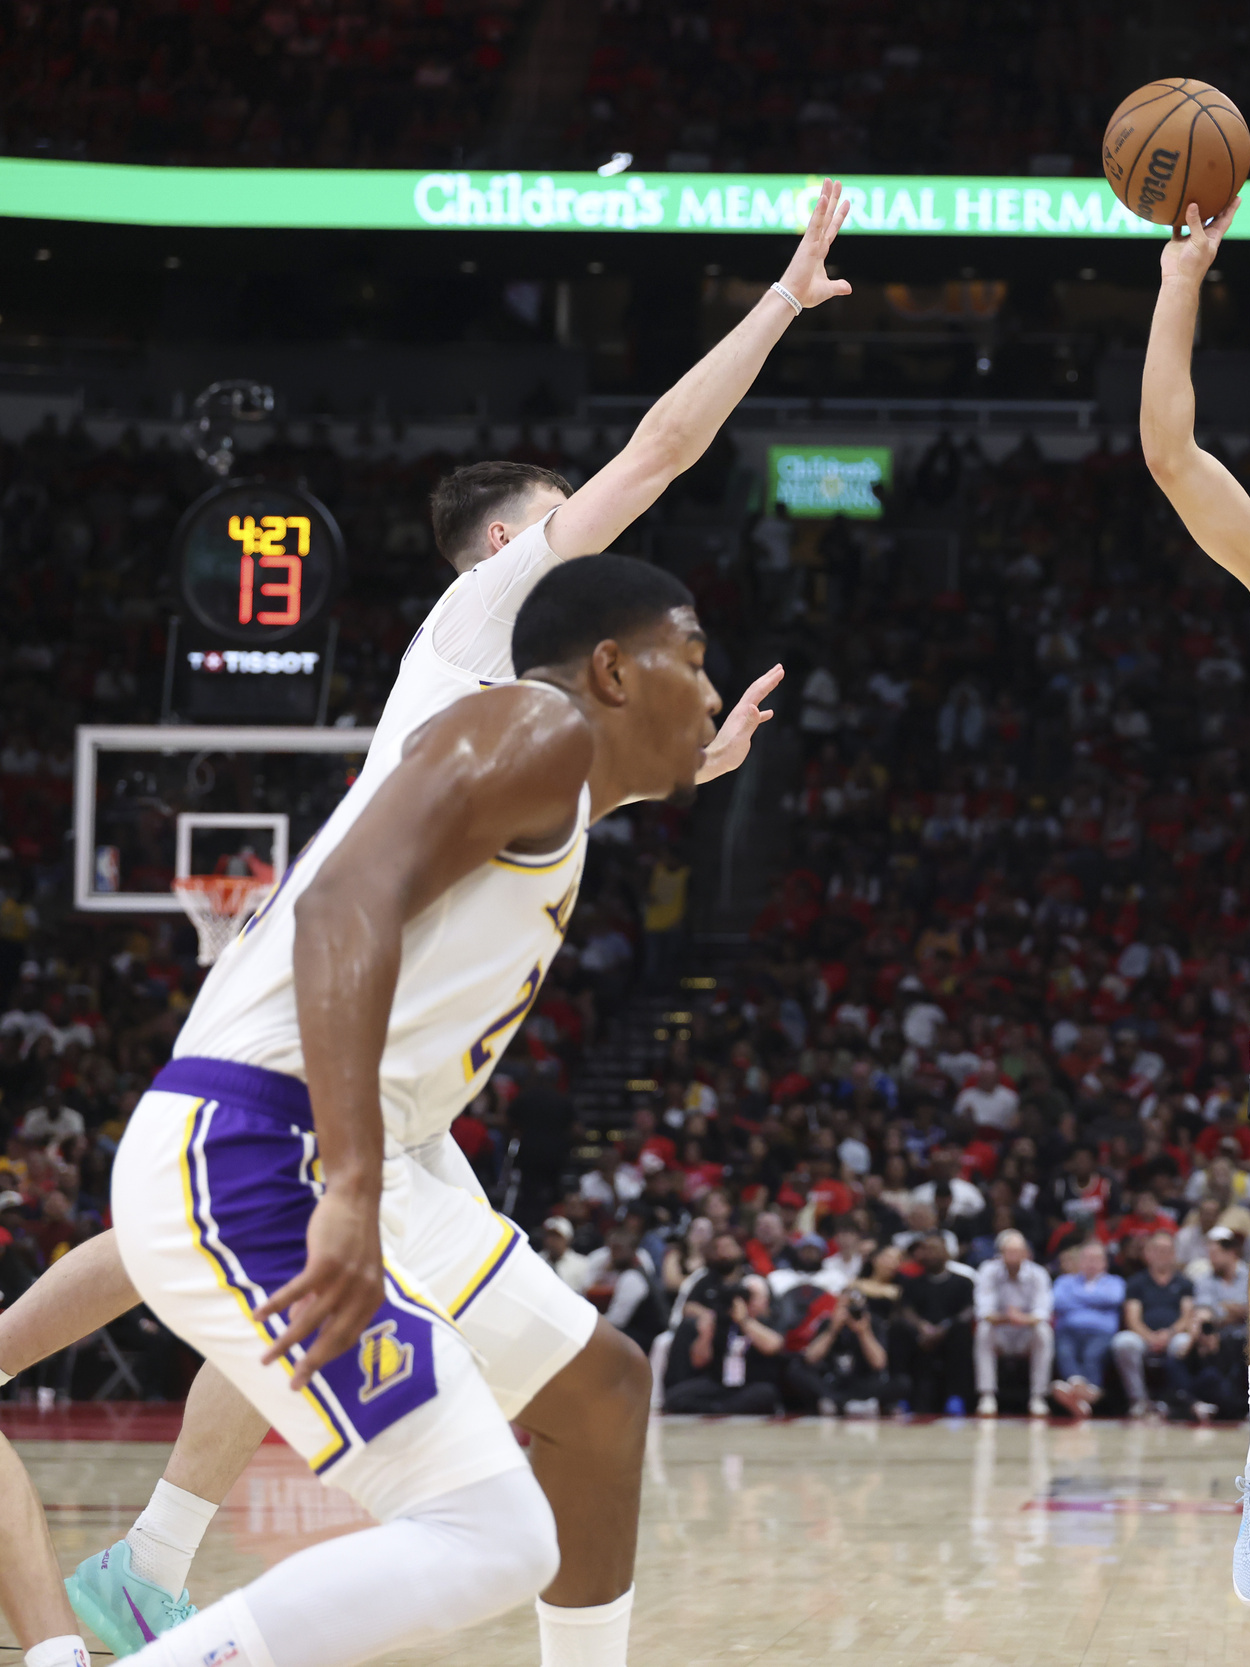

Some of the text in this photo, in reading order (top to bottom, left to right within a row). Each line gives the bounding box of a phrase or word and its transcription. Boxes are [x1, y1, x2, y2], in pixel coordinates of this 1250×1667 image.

[413, 172, 669, 230] Children's
[954, 187, 1160, 233] HERMA
[1137, 147, 1180, 220] Wilso
[228, 515, 311, 556] 4:27
[238, 555, 302, 625] 13
